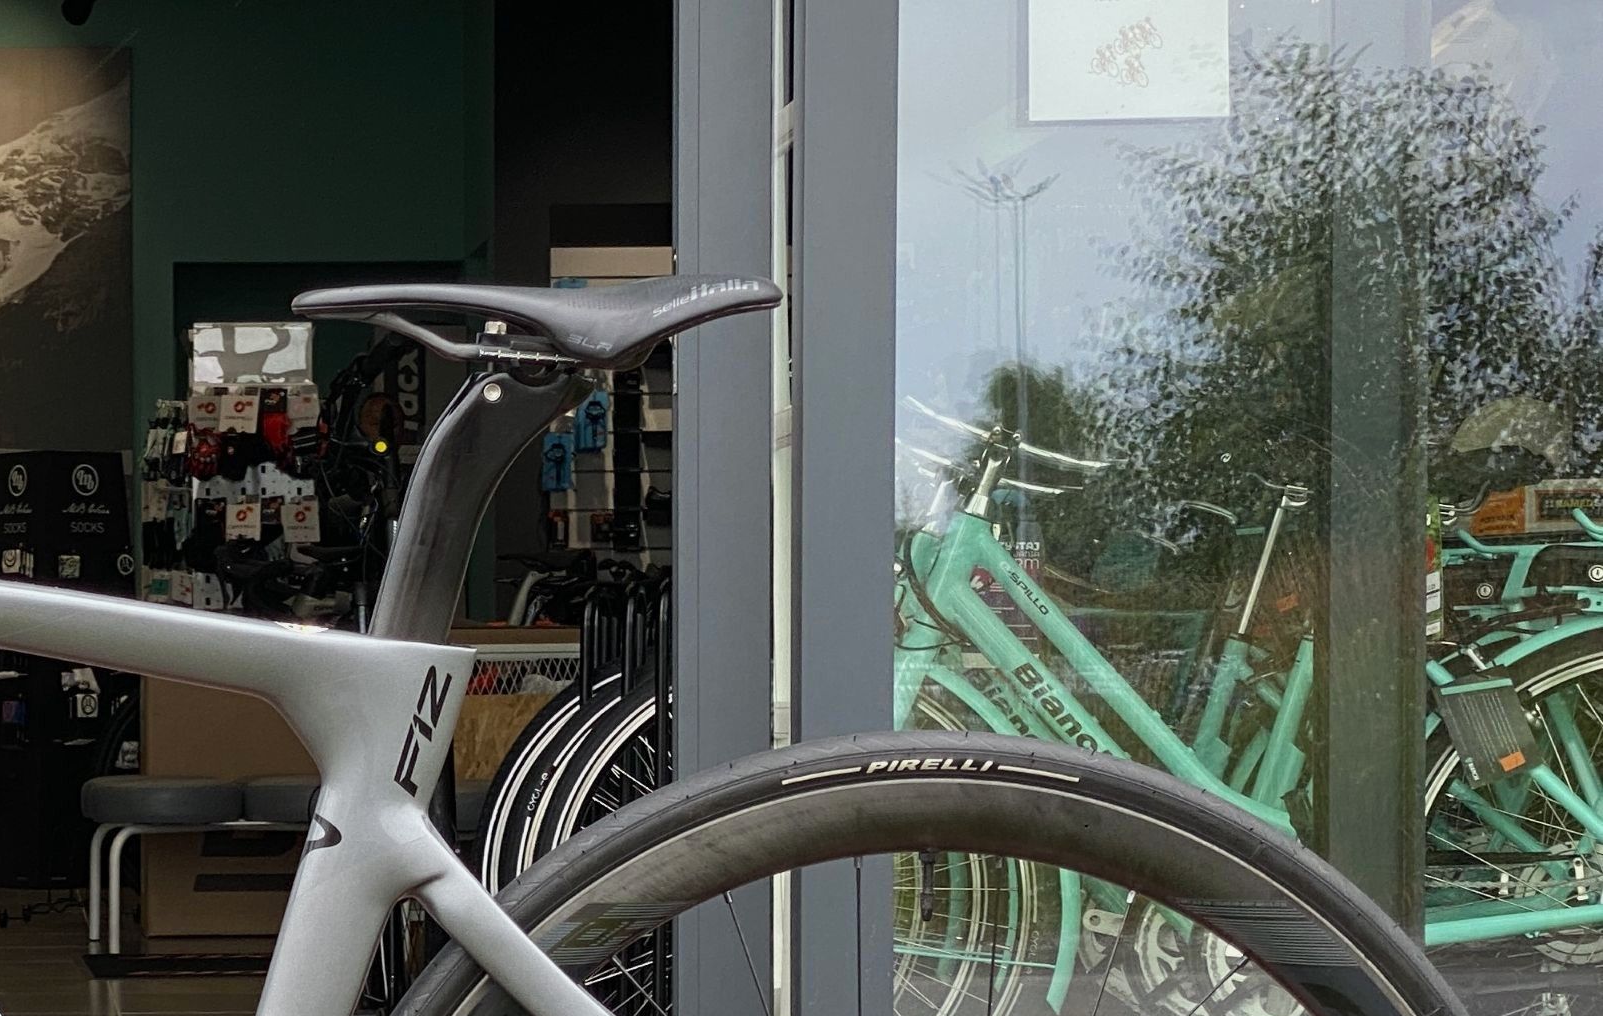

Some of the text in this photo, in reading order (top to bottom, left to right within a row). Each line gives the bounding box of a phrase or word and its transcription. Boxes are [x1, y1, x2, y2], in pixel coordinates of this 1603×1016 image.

[566, 333, 613, 352] SLR
[70, 521, 105, 534] SOCKS
[394, 665, 452, 798] F12
[866, 758, 994, 774] PIRELLI
